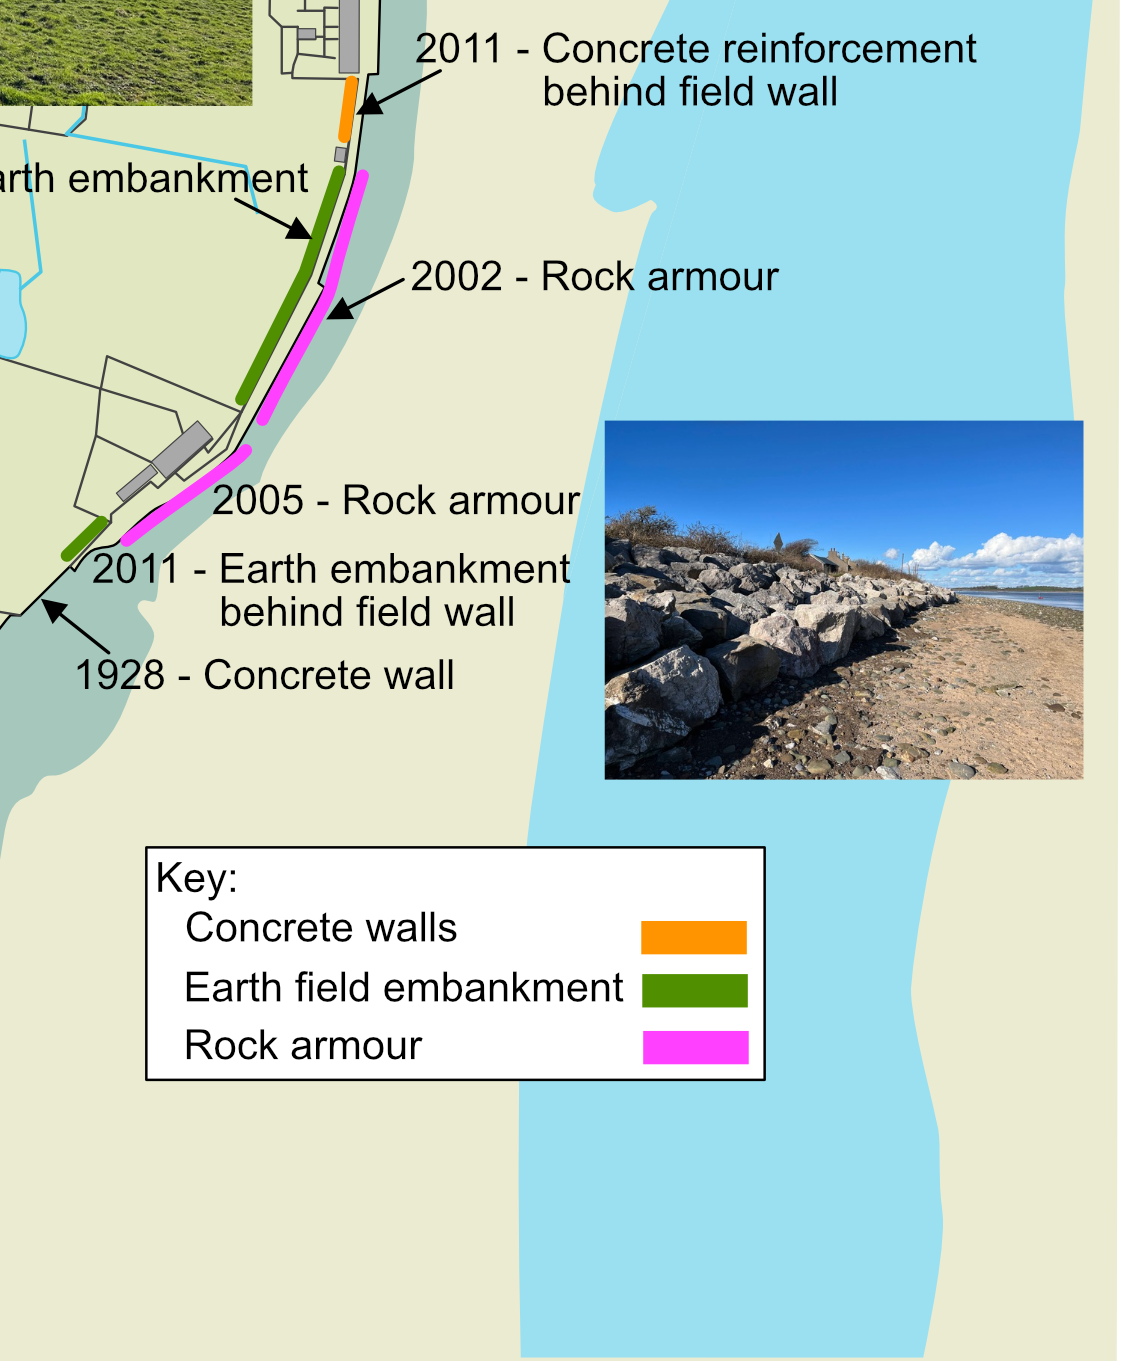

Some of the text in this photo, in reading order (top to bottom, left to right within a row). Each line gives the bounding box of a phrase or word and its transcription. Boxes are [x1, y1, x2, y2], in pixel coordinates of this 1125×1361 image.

[416, 32, 497, 64] 2011
[543, 31, 710, 64] Concrete
[724, 31, 977, 64] reinforcement
[544, 75, 837, 107] behind field wall
[68, 162, 309, 193] embankment
[411, 260, 502, 291] 2002
[543, 260, 635, 291] Rock
[648, 268, 780, 291] armour
[212, 484, 303, 515] 2005
[344, 484, 437, 515] Rock
[449, 491, 581, 515] armour
[92, 552, 174, 584] 2011
[221, 552, 316, 584] Earth
[331, 552, 571, 584] embankment
[221, 595, 514, 627] behind field wall
[77, 658, 165, 690] 1928
[204, 658, 371, 690] Concrete
[383, 658, 453, 690] wall
[158, 861, 236, 901] Key:
[186, 911, 457, 943] Concrete walls
[186, 970, 624, 1003] Earth field embankment
[186, 1029, 423, 1060] Rock armour
